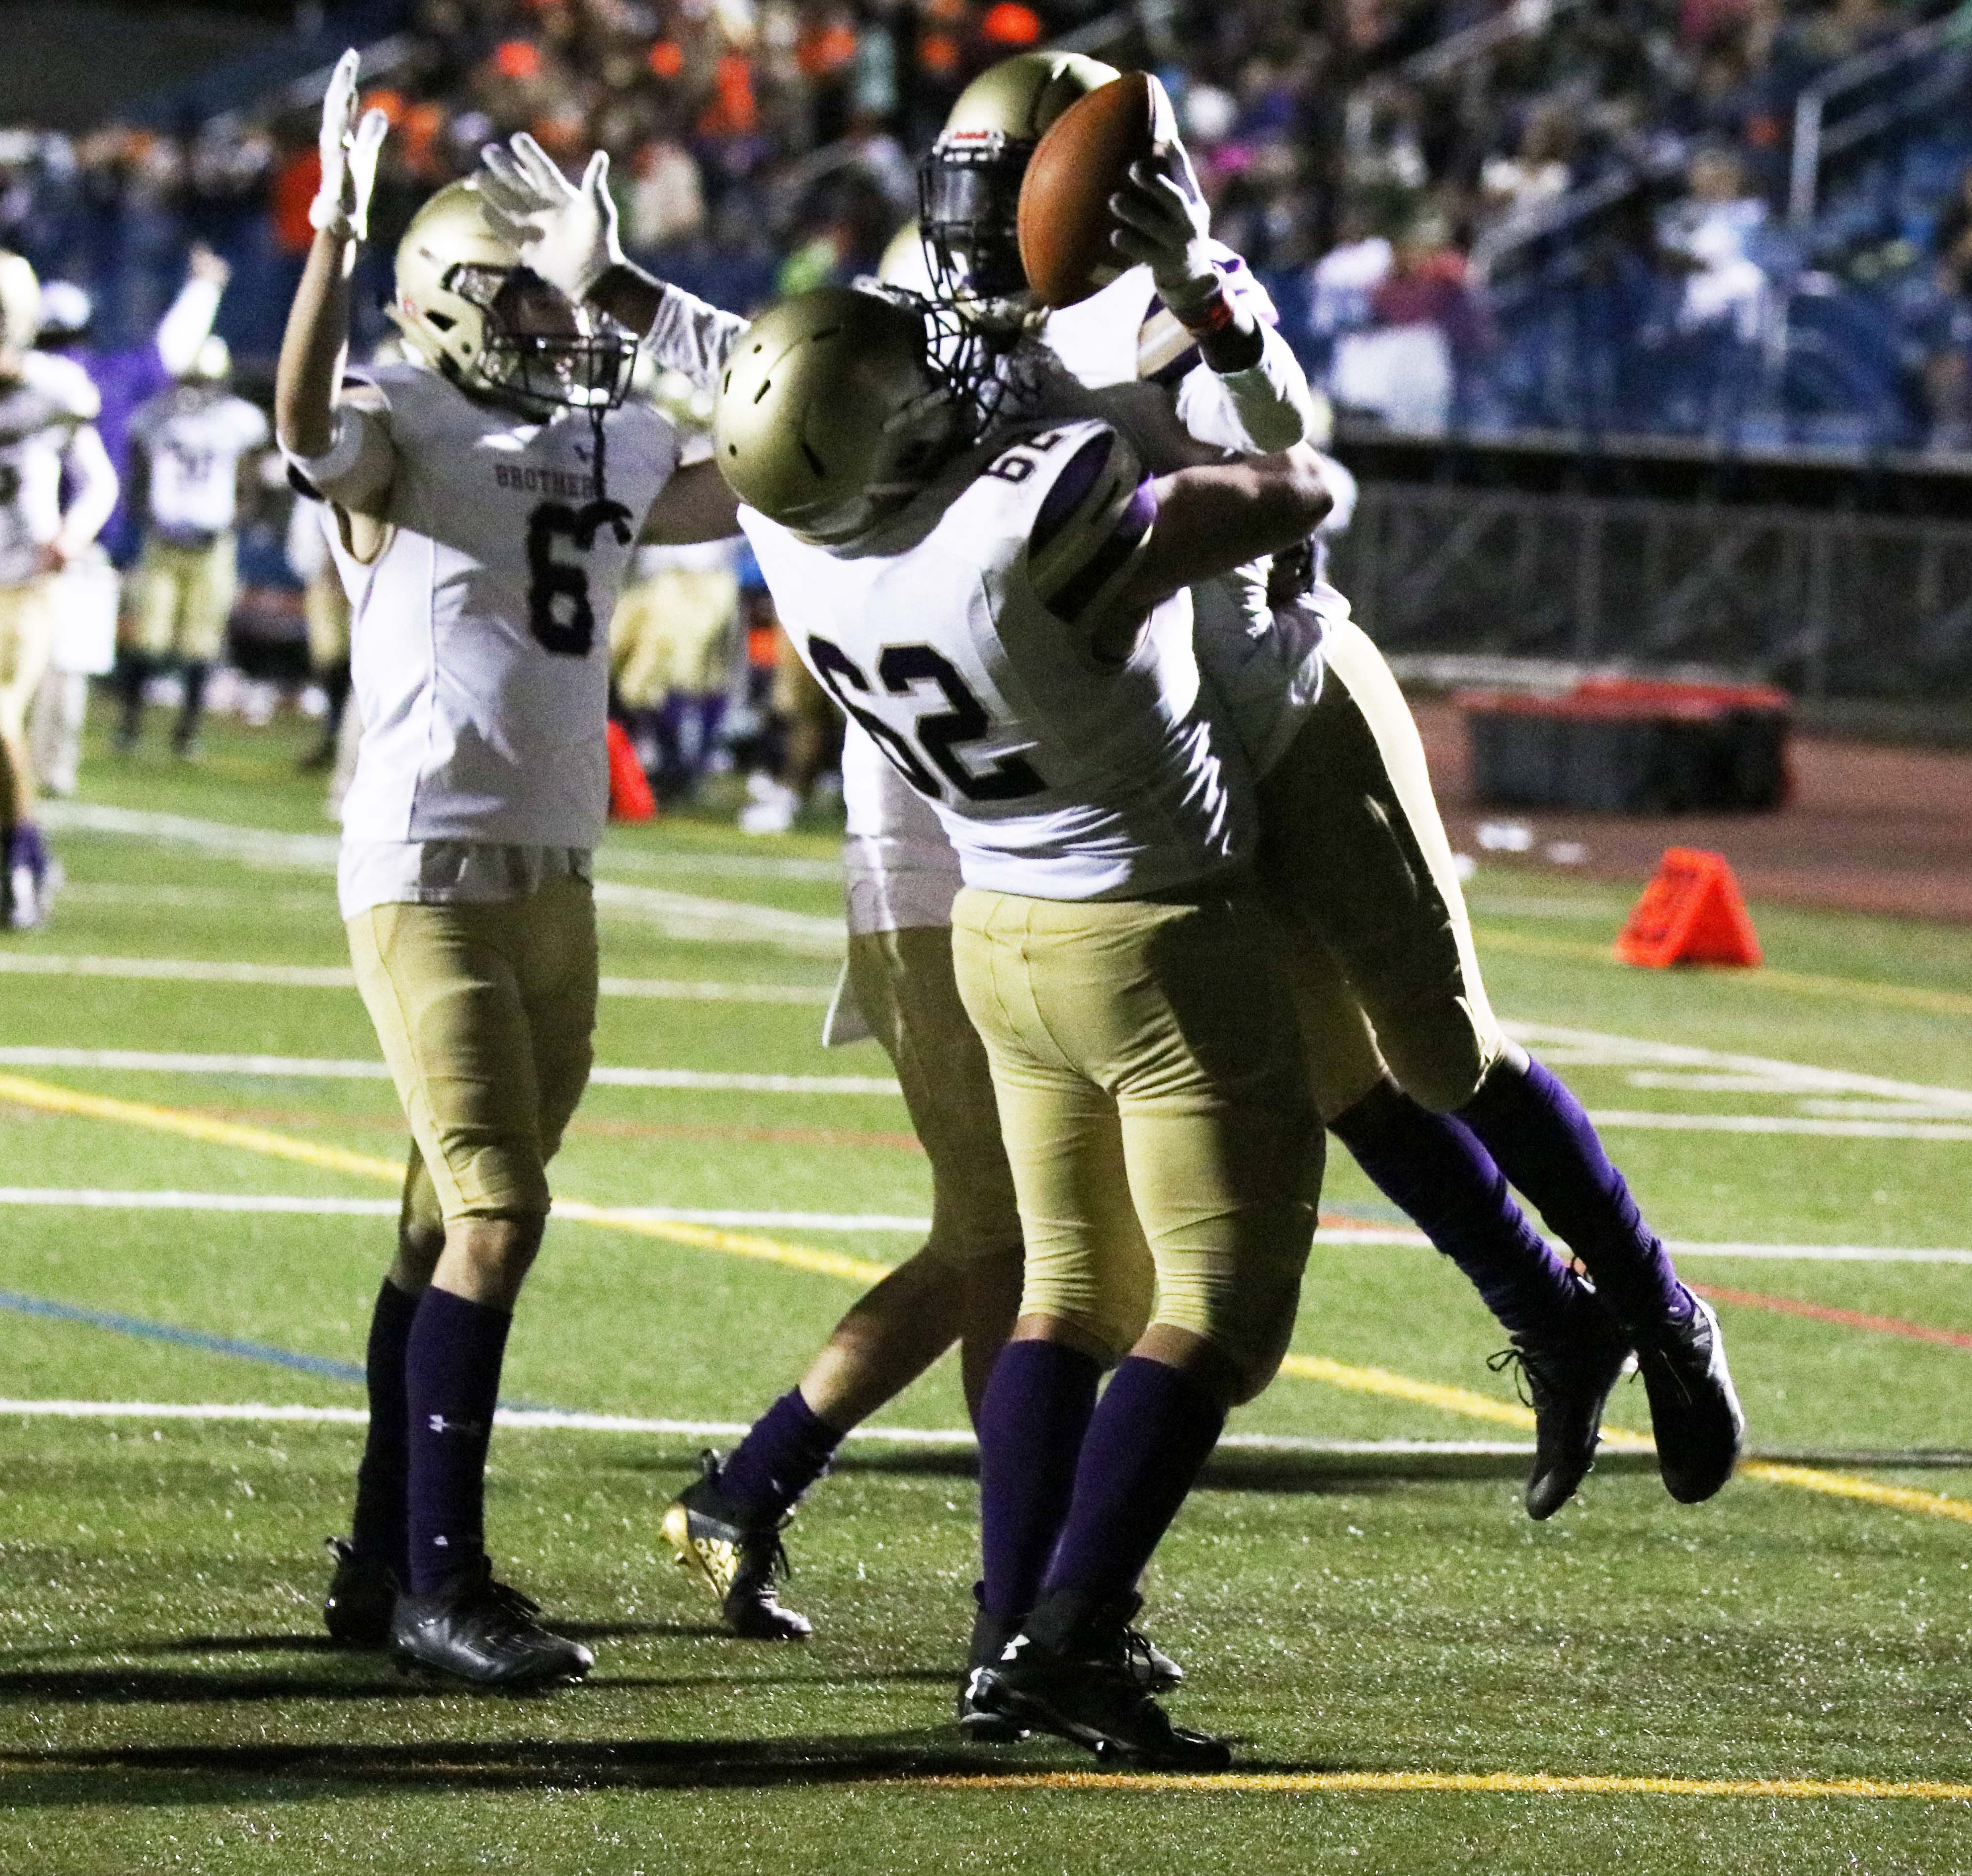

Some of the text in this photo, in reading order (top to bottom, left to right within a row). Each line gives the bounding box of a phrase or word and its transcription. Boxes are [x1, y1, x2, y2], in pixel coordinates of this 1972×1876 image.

[495, 464, 606, 497] BROTHER
[526, 502, 595, 657] 6
[807, 632, 1047, 801] 62
